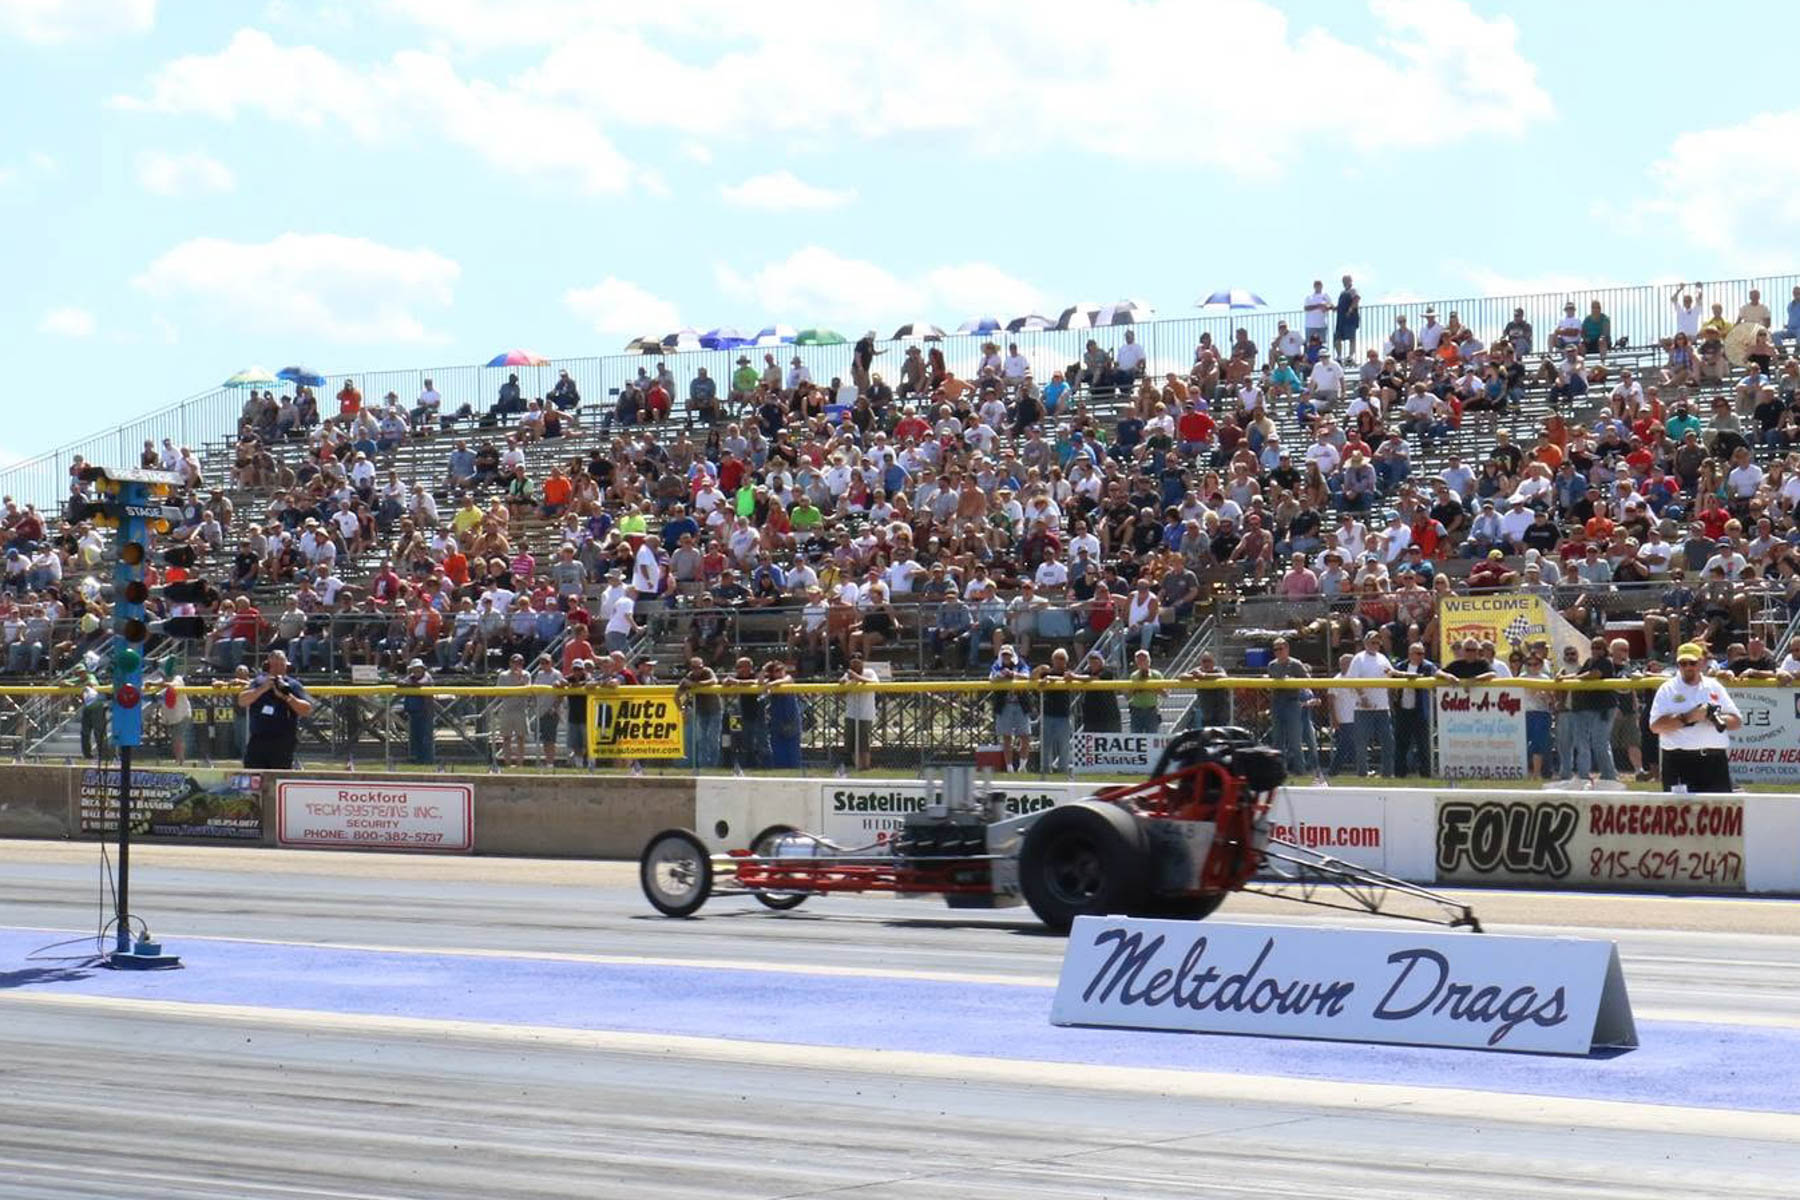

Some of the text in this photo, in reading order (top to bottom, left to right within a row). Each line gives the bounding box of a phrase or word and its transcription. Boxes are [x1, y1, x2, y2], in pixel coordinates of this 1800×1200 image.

[1446, 599, 1529, 612] WELCOME
[616, 700, 667, 719] Auto
[612, 720, 677, 741] Meter
[1093, 738, 1148, 753] RACE
[1093, 753, 1148, 766] ENGINES
[1727, 748, 1777, 763] HAULER
[337, 790, 408, 804] Rockford
[833, 790, 928, 813] Stateline
[414, 807, 443, 820] INC.
[1590, 803, 1743, 837] RACECARS.COM
[346, 819, 400, 829] SECURITY
[352, 830, 444, 843] 800-382-5737
[1438, 802, 1579, 878] FOLK
[1589, 846, 1742, 883] 815-629-2417
[1083, 928, 1569, 1046] Meltdown Drags
